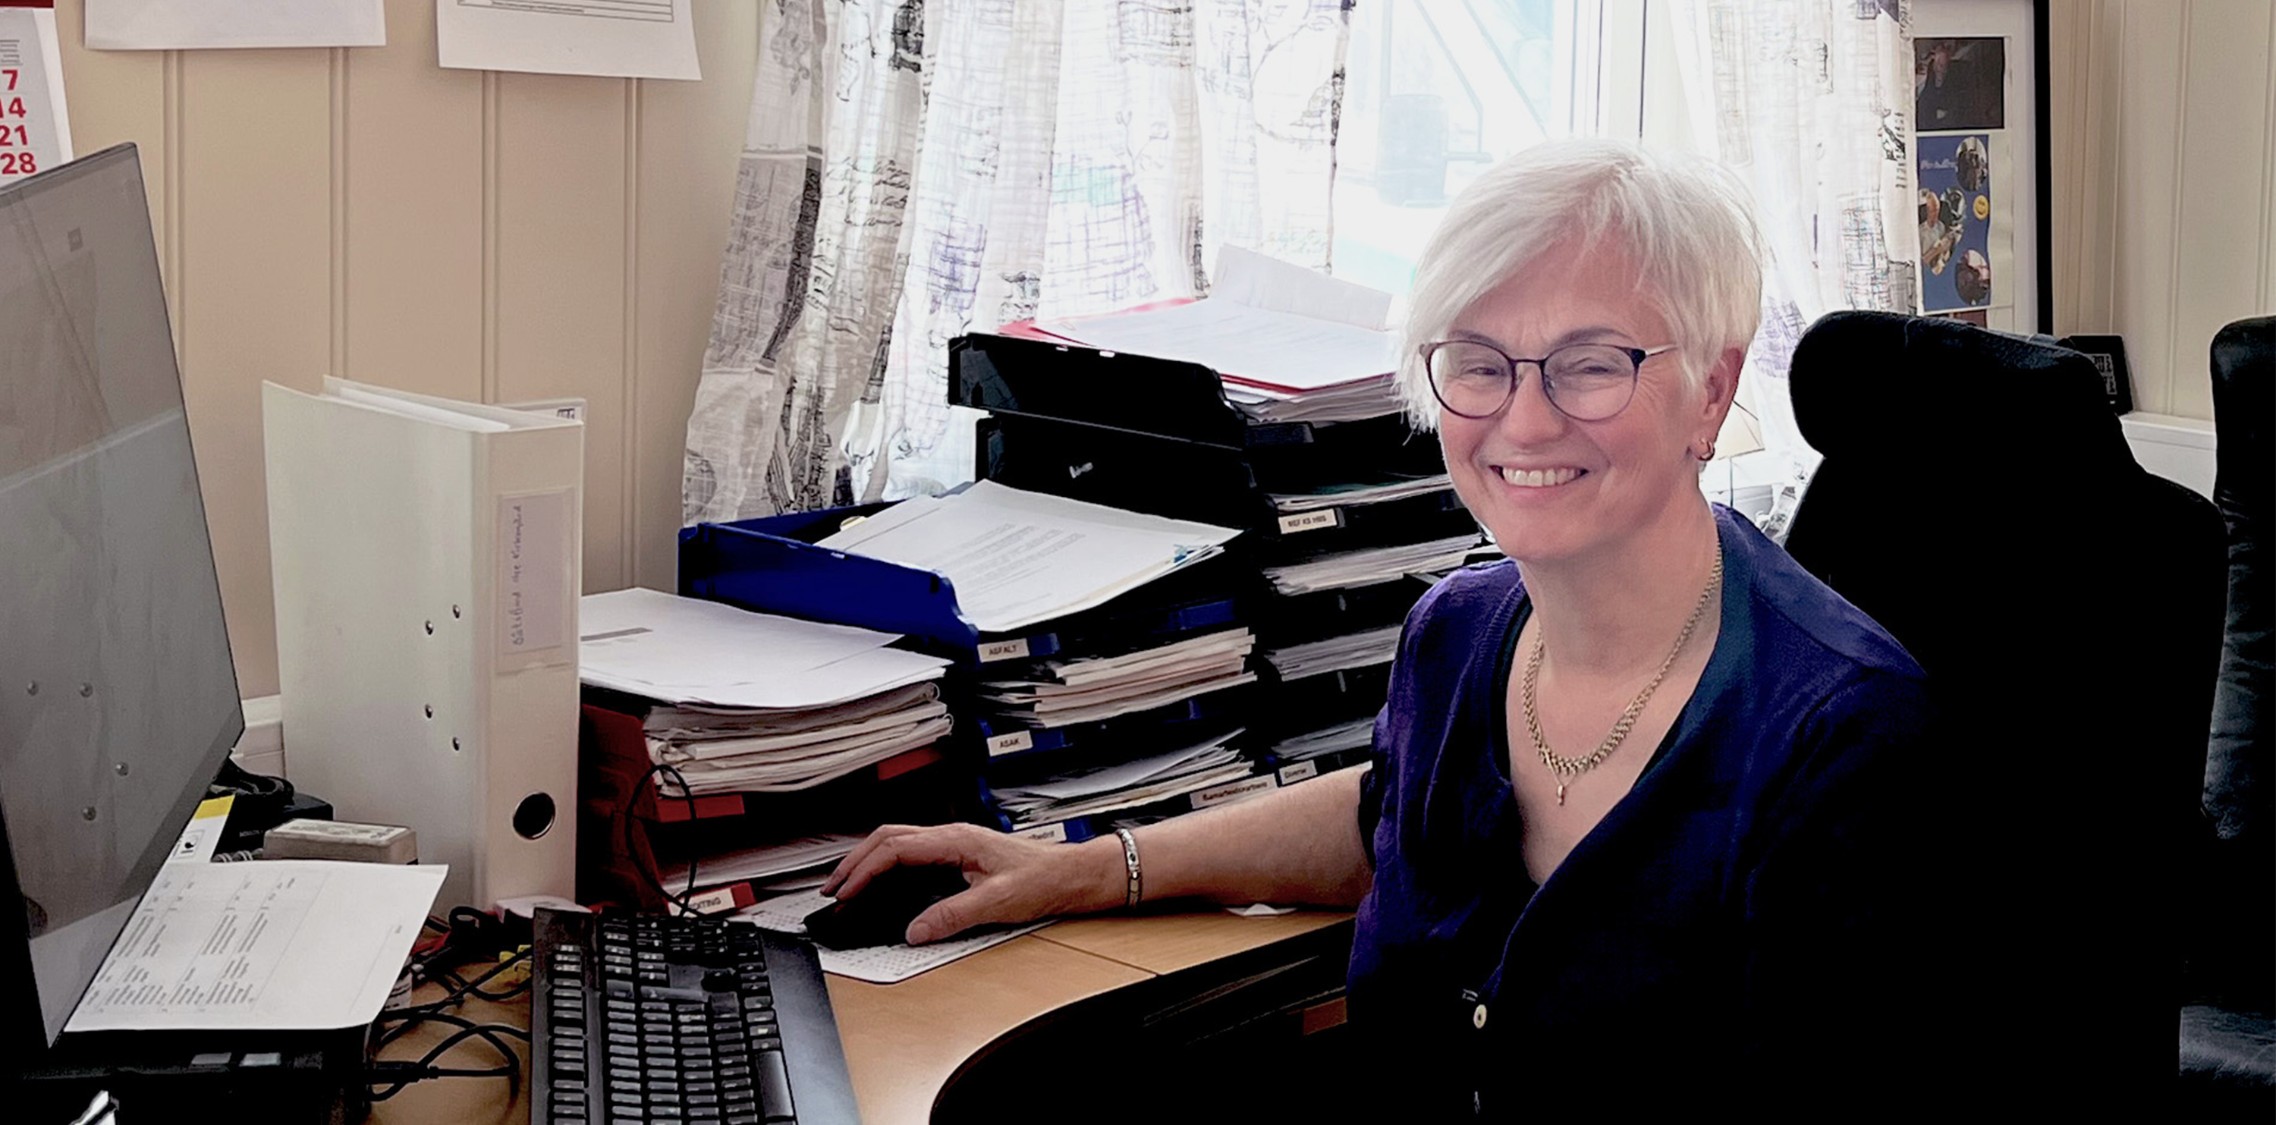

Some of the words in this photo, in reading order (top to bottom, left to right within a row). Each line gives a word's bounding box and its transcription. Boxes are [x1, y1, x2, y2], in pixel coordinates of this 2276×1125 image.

[2, 69, 19, 91] 7
[0, 125, 28, 146] 21
[0, 153, 37, 174] 28
